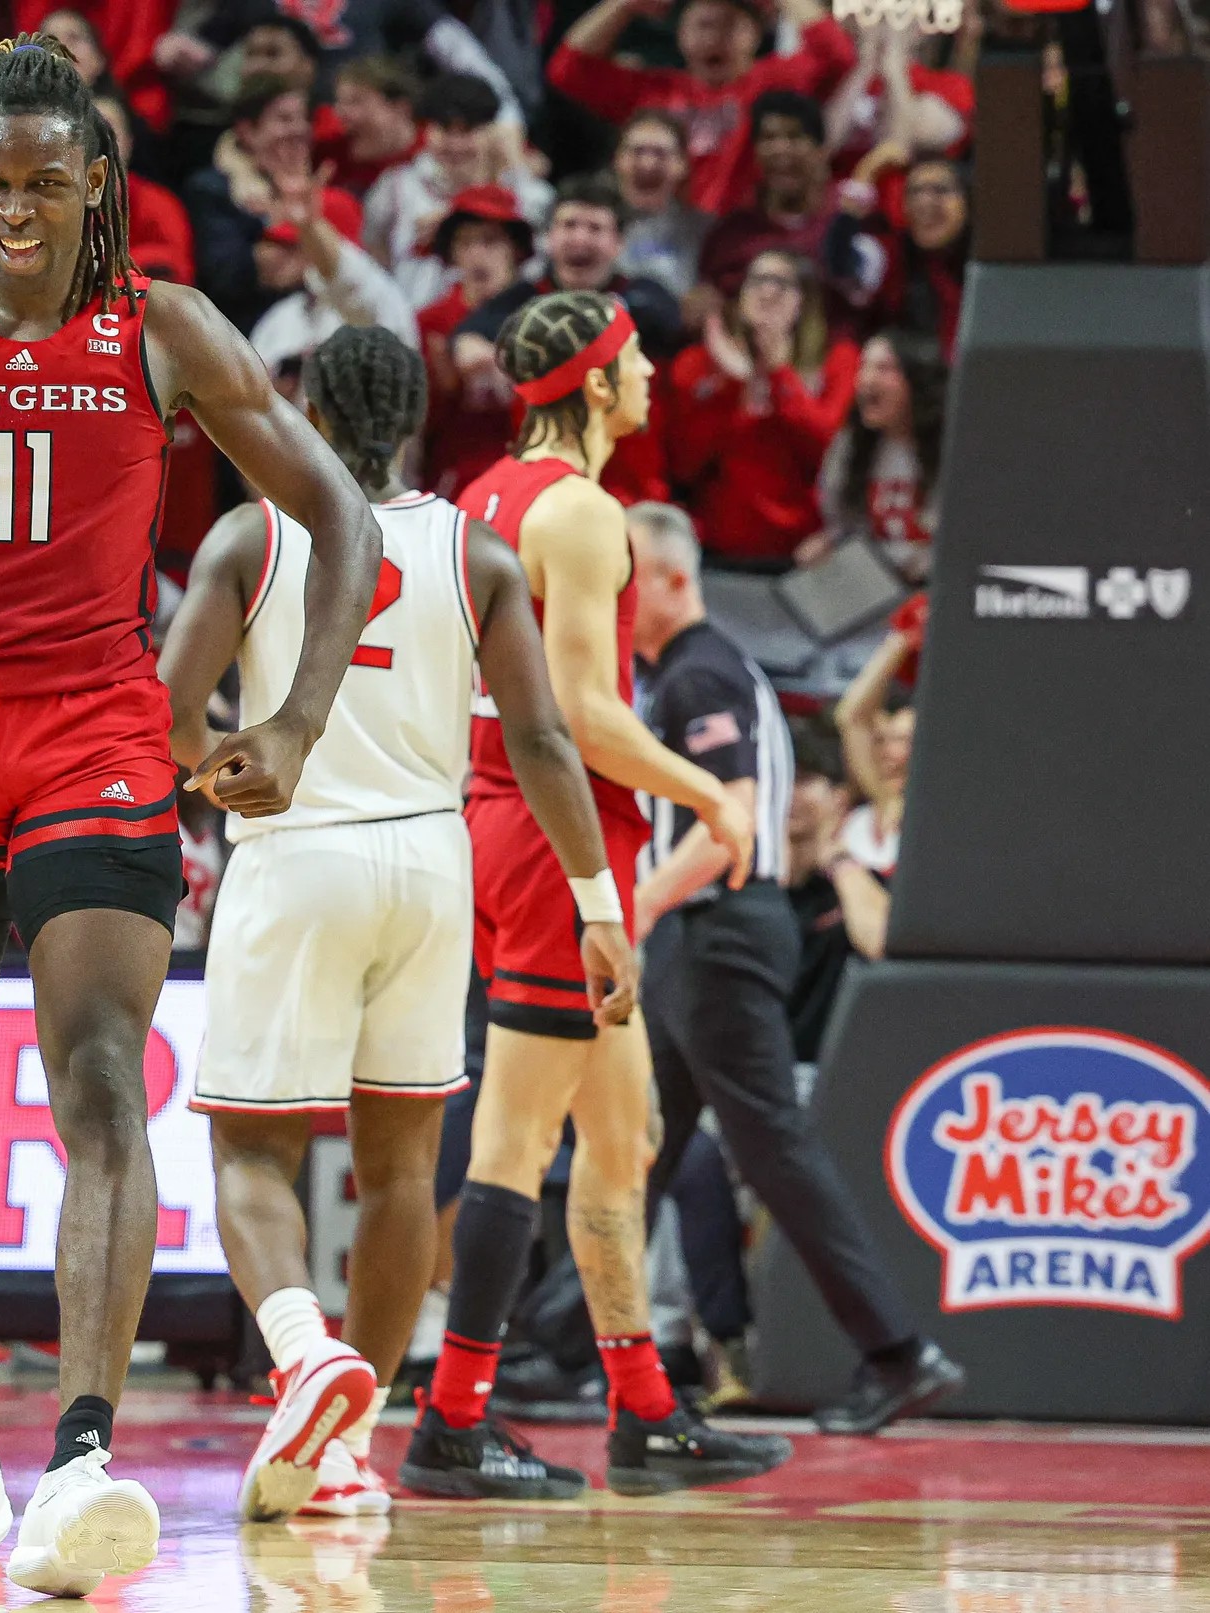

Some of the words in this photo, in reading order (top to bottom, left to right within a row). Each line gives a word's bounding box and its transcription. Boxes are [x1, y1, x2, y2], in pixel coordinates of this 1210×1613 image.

[92, 313, 119, 337] C
[5, 361, 39, 371] adidas
[100, 790, 135, 803] adidas
[942, 1080, 1186, 1170] Jersey
[964, 1250, 1160, 1299] ARENA
